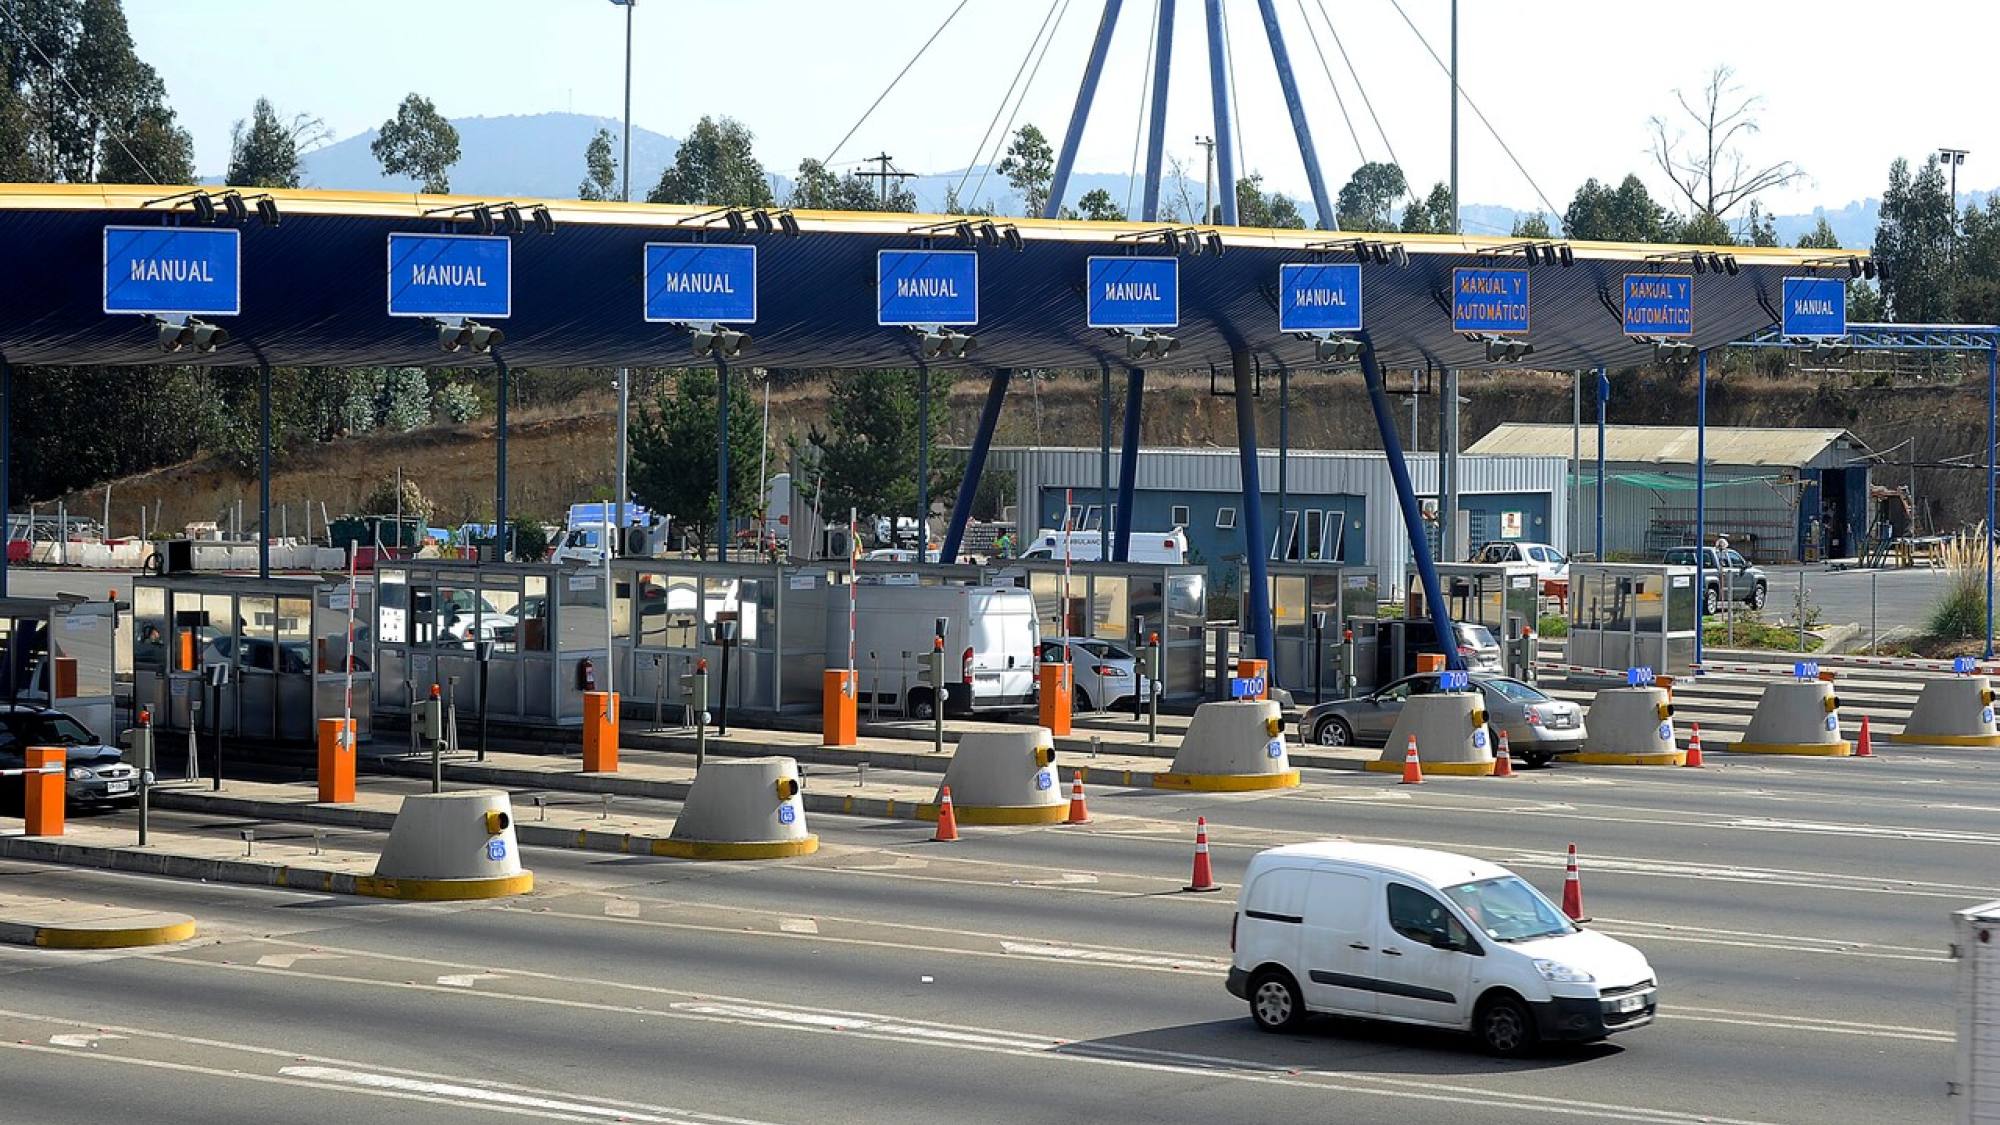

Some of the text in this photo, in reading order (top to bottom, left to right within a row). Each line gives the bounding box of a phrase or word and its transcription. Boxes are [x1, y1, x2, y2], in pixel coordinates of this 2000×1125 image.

[130, 258, 214, 283] MANUAL
[412, 263, 488, 287] MANUAL
[666, 272, 735, 294] MANUAL
[897, 277, 959, 298] MANUAL
[1105, 282, 1162, 301] MANUAL
[1460, 276, 1522, 296] MANUAL Y
[1630, 281, 1687, 300] MANUAL Y
[1295, 287, 1347, 307] MANUAL
[1794, 299, 1835, 315] MANUAL
[1456, 299, 1526, 322] AUTOMÁTICO
[1626, 304, 1691, 325] AUTOMÁTICO
[1636, 666, 1652, 683] 700
[1802, 661, 1818, 677] 700
[1241, 678, 1264, 695] 700
[1450, 671, 1468, 688] 700
